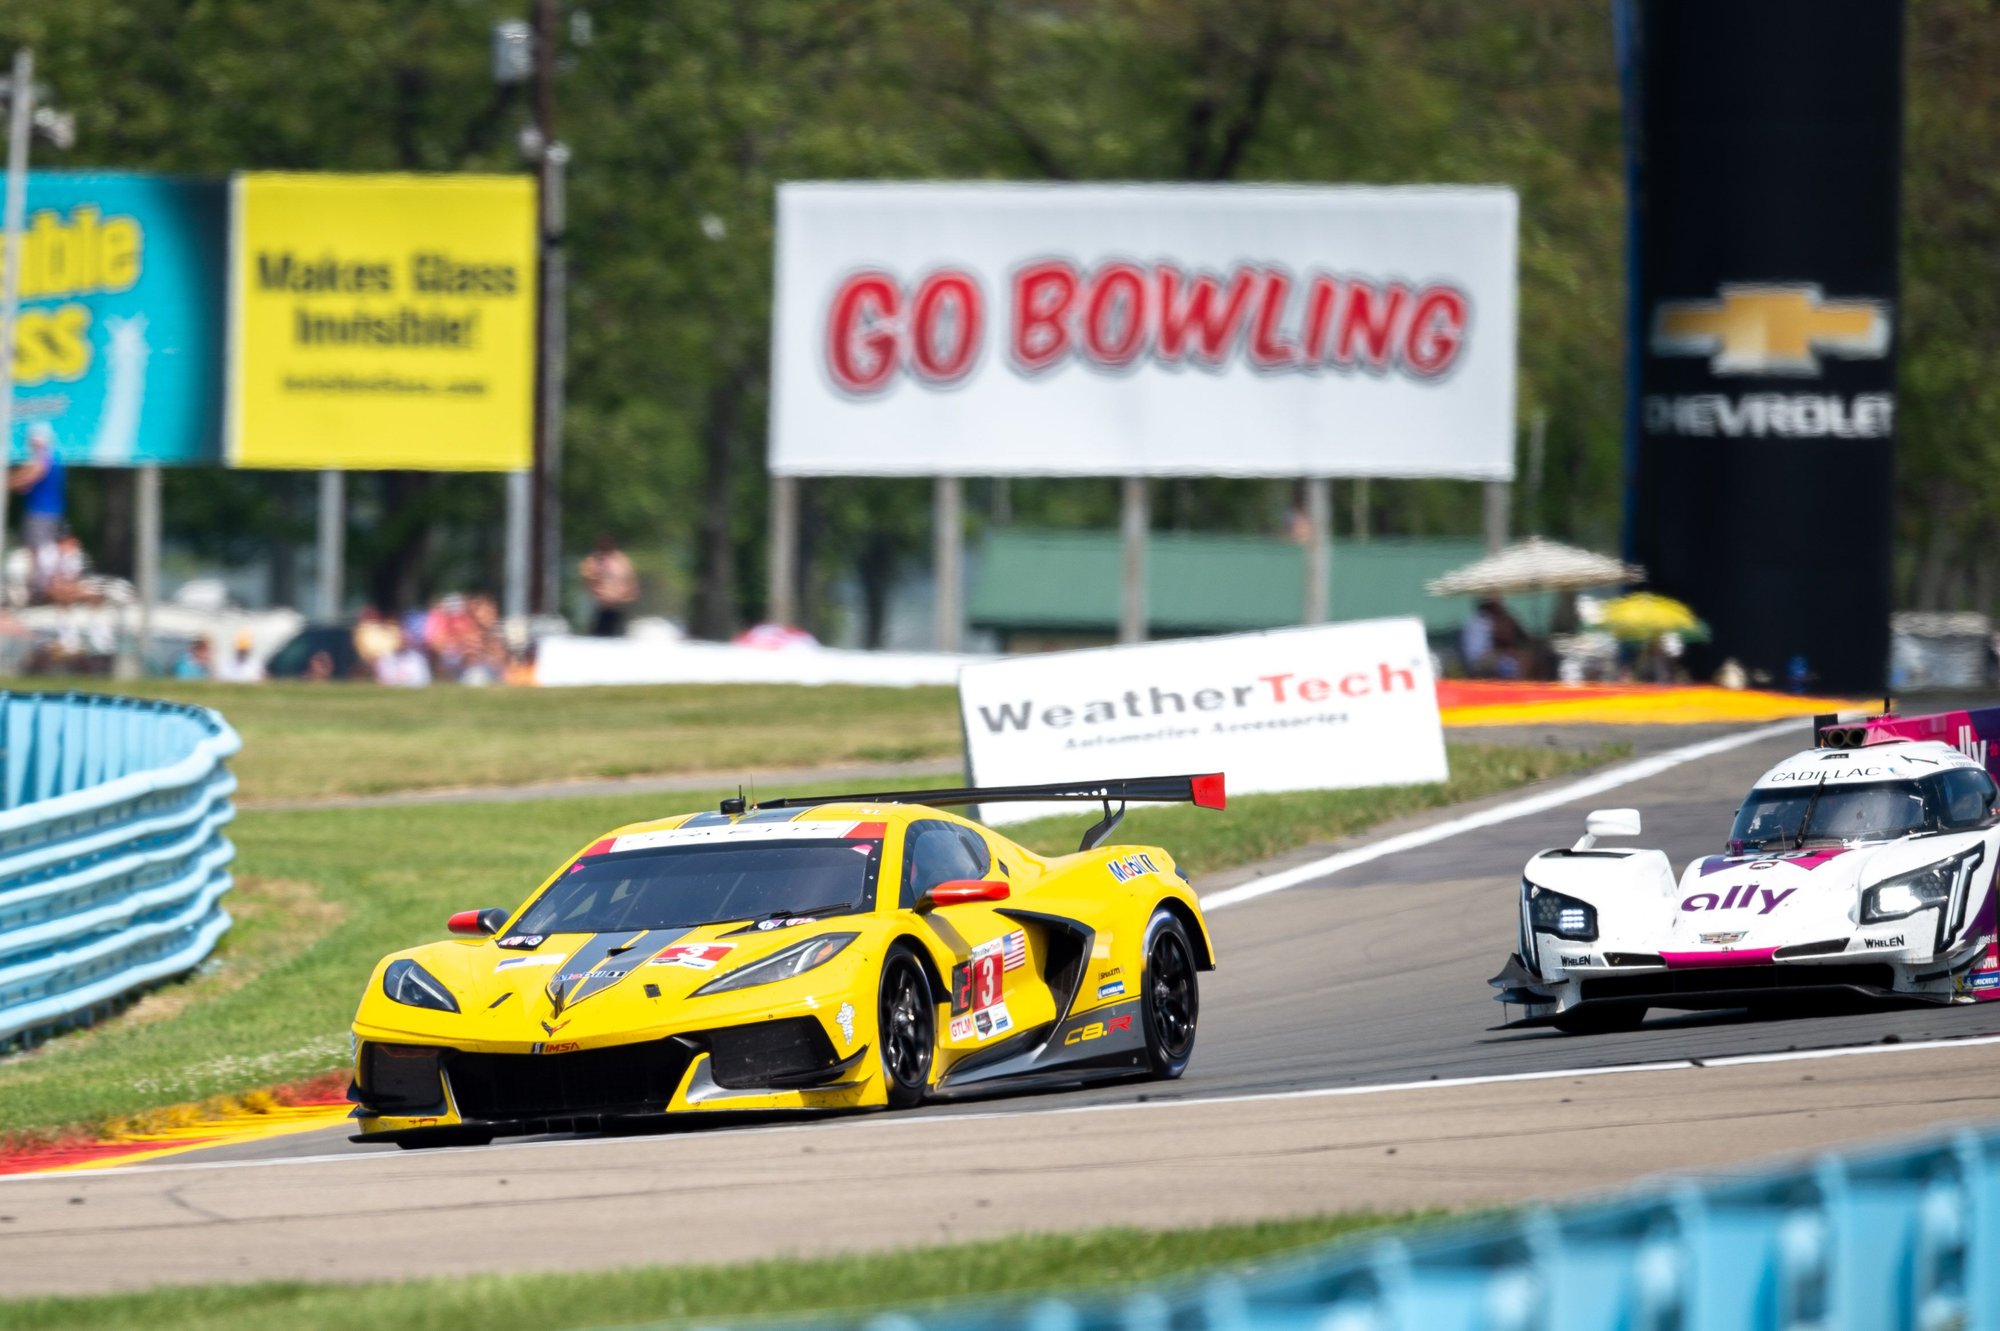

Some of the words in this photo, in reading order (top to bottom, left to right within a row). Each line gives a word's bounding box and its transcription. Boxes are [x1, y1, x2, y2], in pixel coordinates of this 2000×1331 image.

[824, 270, 984, 394] GO
[1011, 260, 1468, 378] BOWLING
[1957, 724, 1988, 769] lly
[1771, 766, 1881, 783] CADILLAC
[1107, 855, 1149, 883] Mobil
[1680, 884, 1799, 915] ally
[1863, 934, 1905, 949] WHELEN
[1560, 953, 1592, 967] WHELEN
[981, 955, 995, 1008] 3
[951, 1017, 972, 1038] GTLM
[1064, 1014, 1133, 1046] C8.R
[545, 1041, 580, 1054] IMSA
